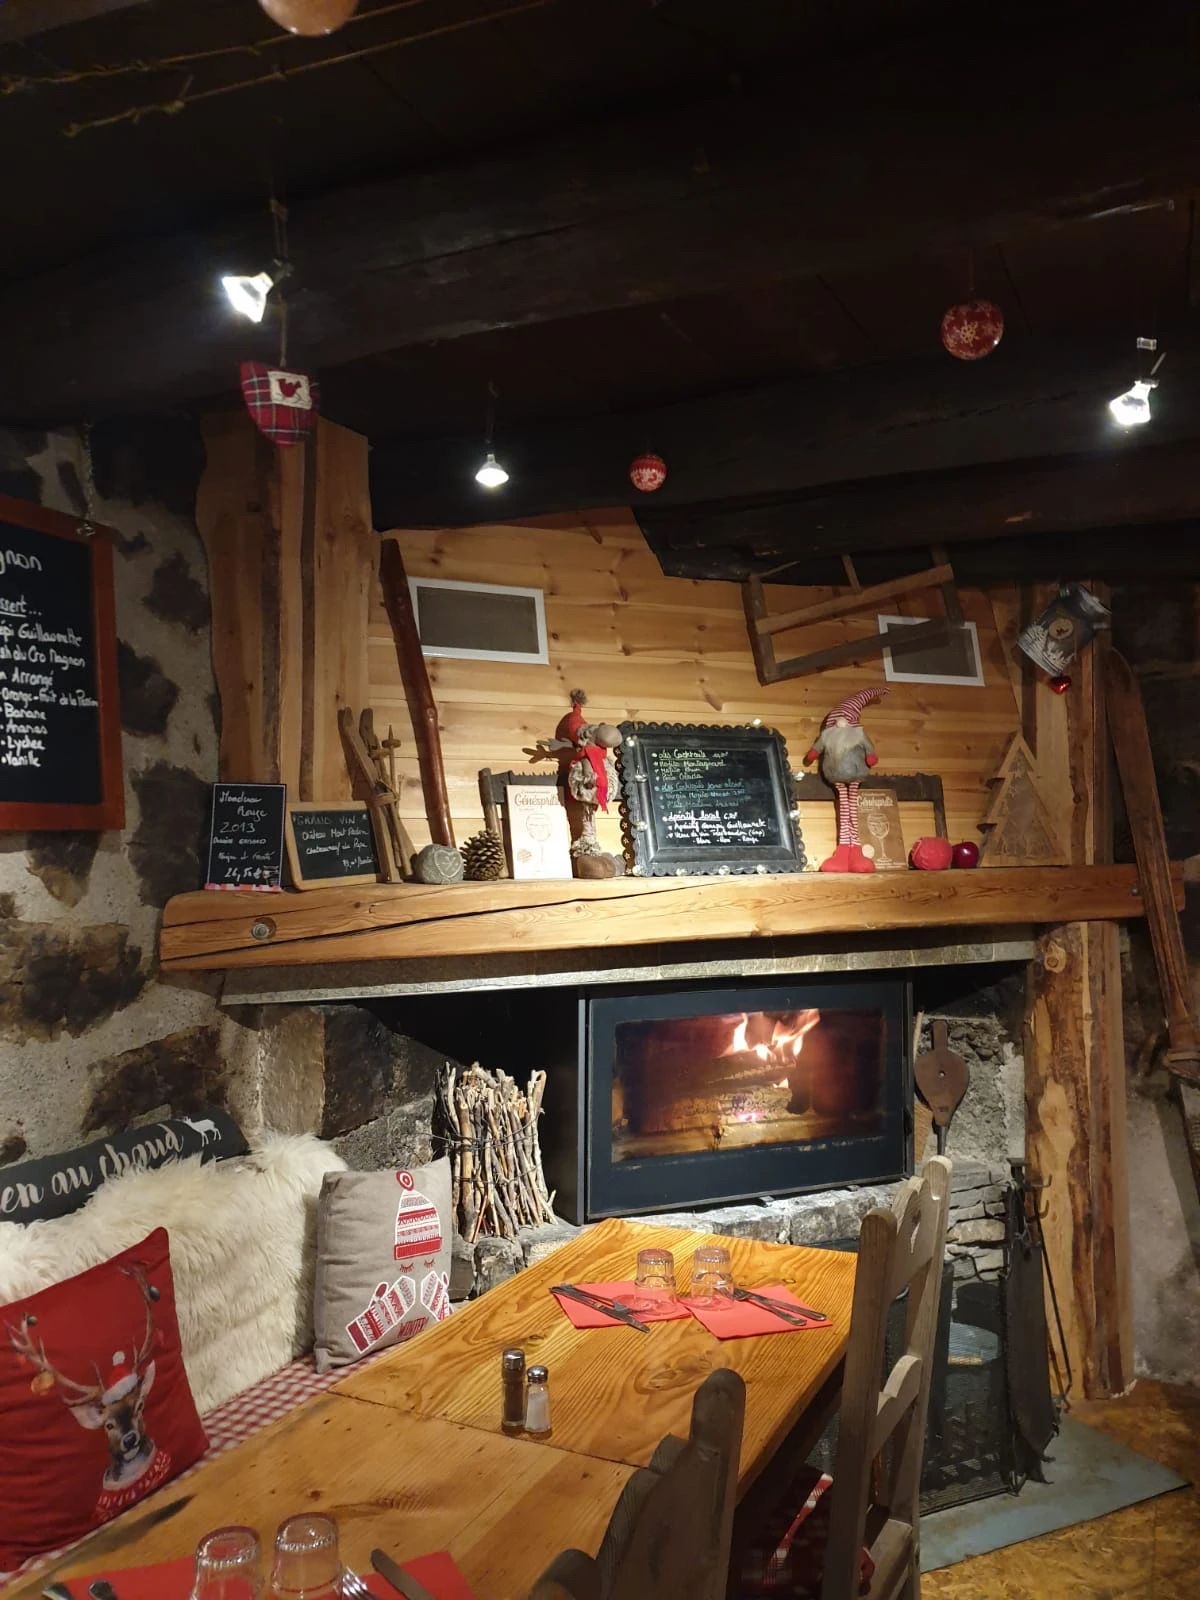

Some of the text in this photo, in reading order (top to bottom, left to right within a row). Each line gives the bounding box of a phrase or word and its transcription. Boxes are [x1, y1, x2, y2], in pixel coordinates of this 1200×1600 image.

[28, 645, 46, 663] Cro
[4, 702, 46, 720] Banane
[339, 815, 356, 825] VIN
[220, 822, 256, 833] 2013
